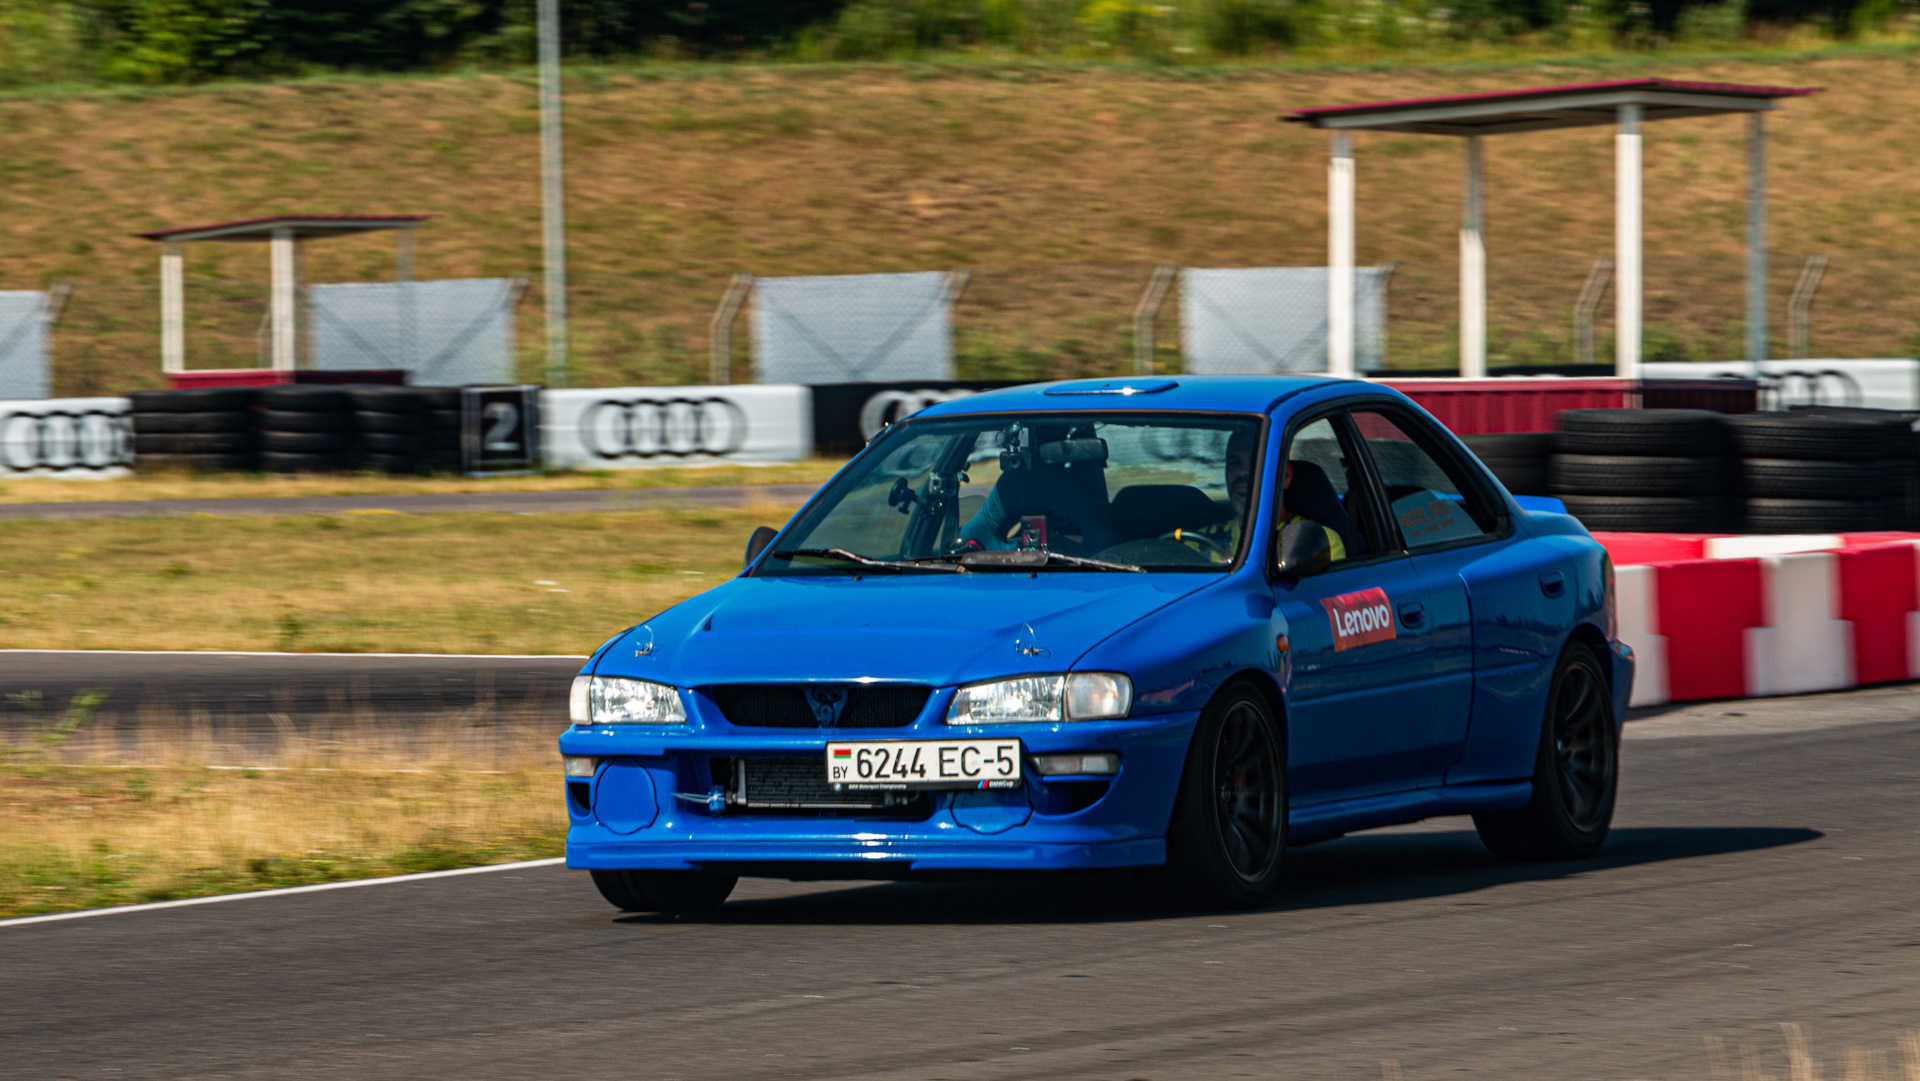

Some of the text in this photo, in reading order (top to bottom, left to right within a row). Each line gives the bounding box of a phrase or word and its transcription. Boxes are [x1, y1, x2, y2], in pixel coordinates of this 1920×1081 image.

[484, 402, 519, 450] 2
[1333, 604, 1390, 637] Lenovo
[833, 766, 848, 779] BY
[857, 745, 1013, 779] 6244 EC-5
